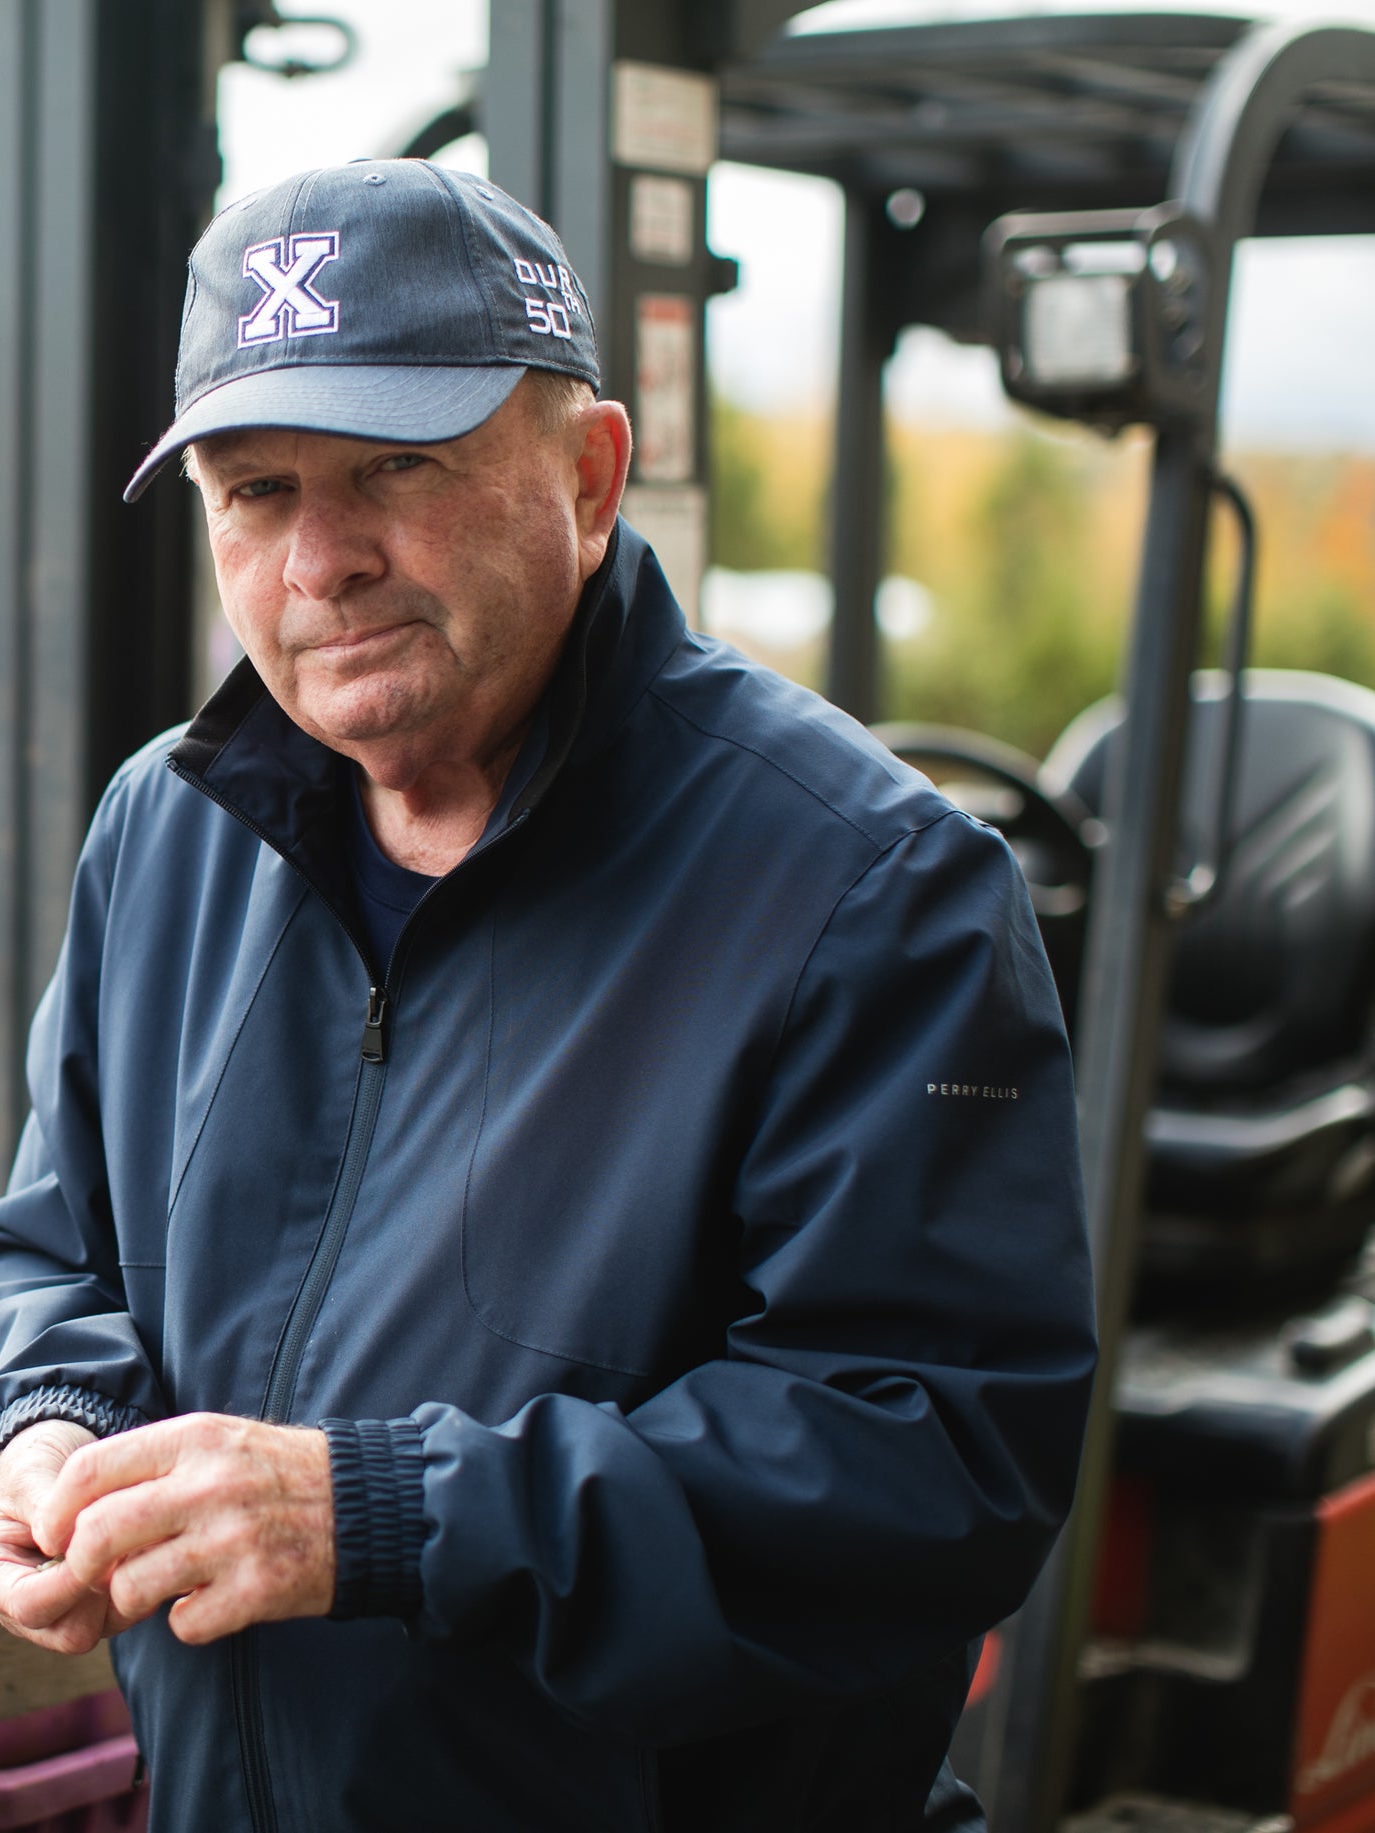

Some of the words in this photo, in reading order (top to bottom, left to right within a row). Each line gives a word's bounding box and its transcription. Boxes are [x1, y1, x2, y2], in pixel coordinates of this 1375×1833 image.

[237, 231, 340, 350] X
[514, 258, 573, 294] OUR
[926, 1083, 978, 1096] PERRY
[982, 1086, 1018, 1099] ELLIS
